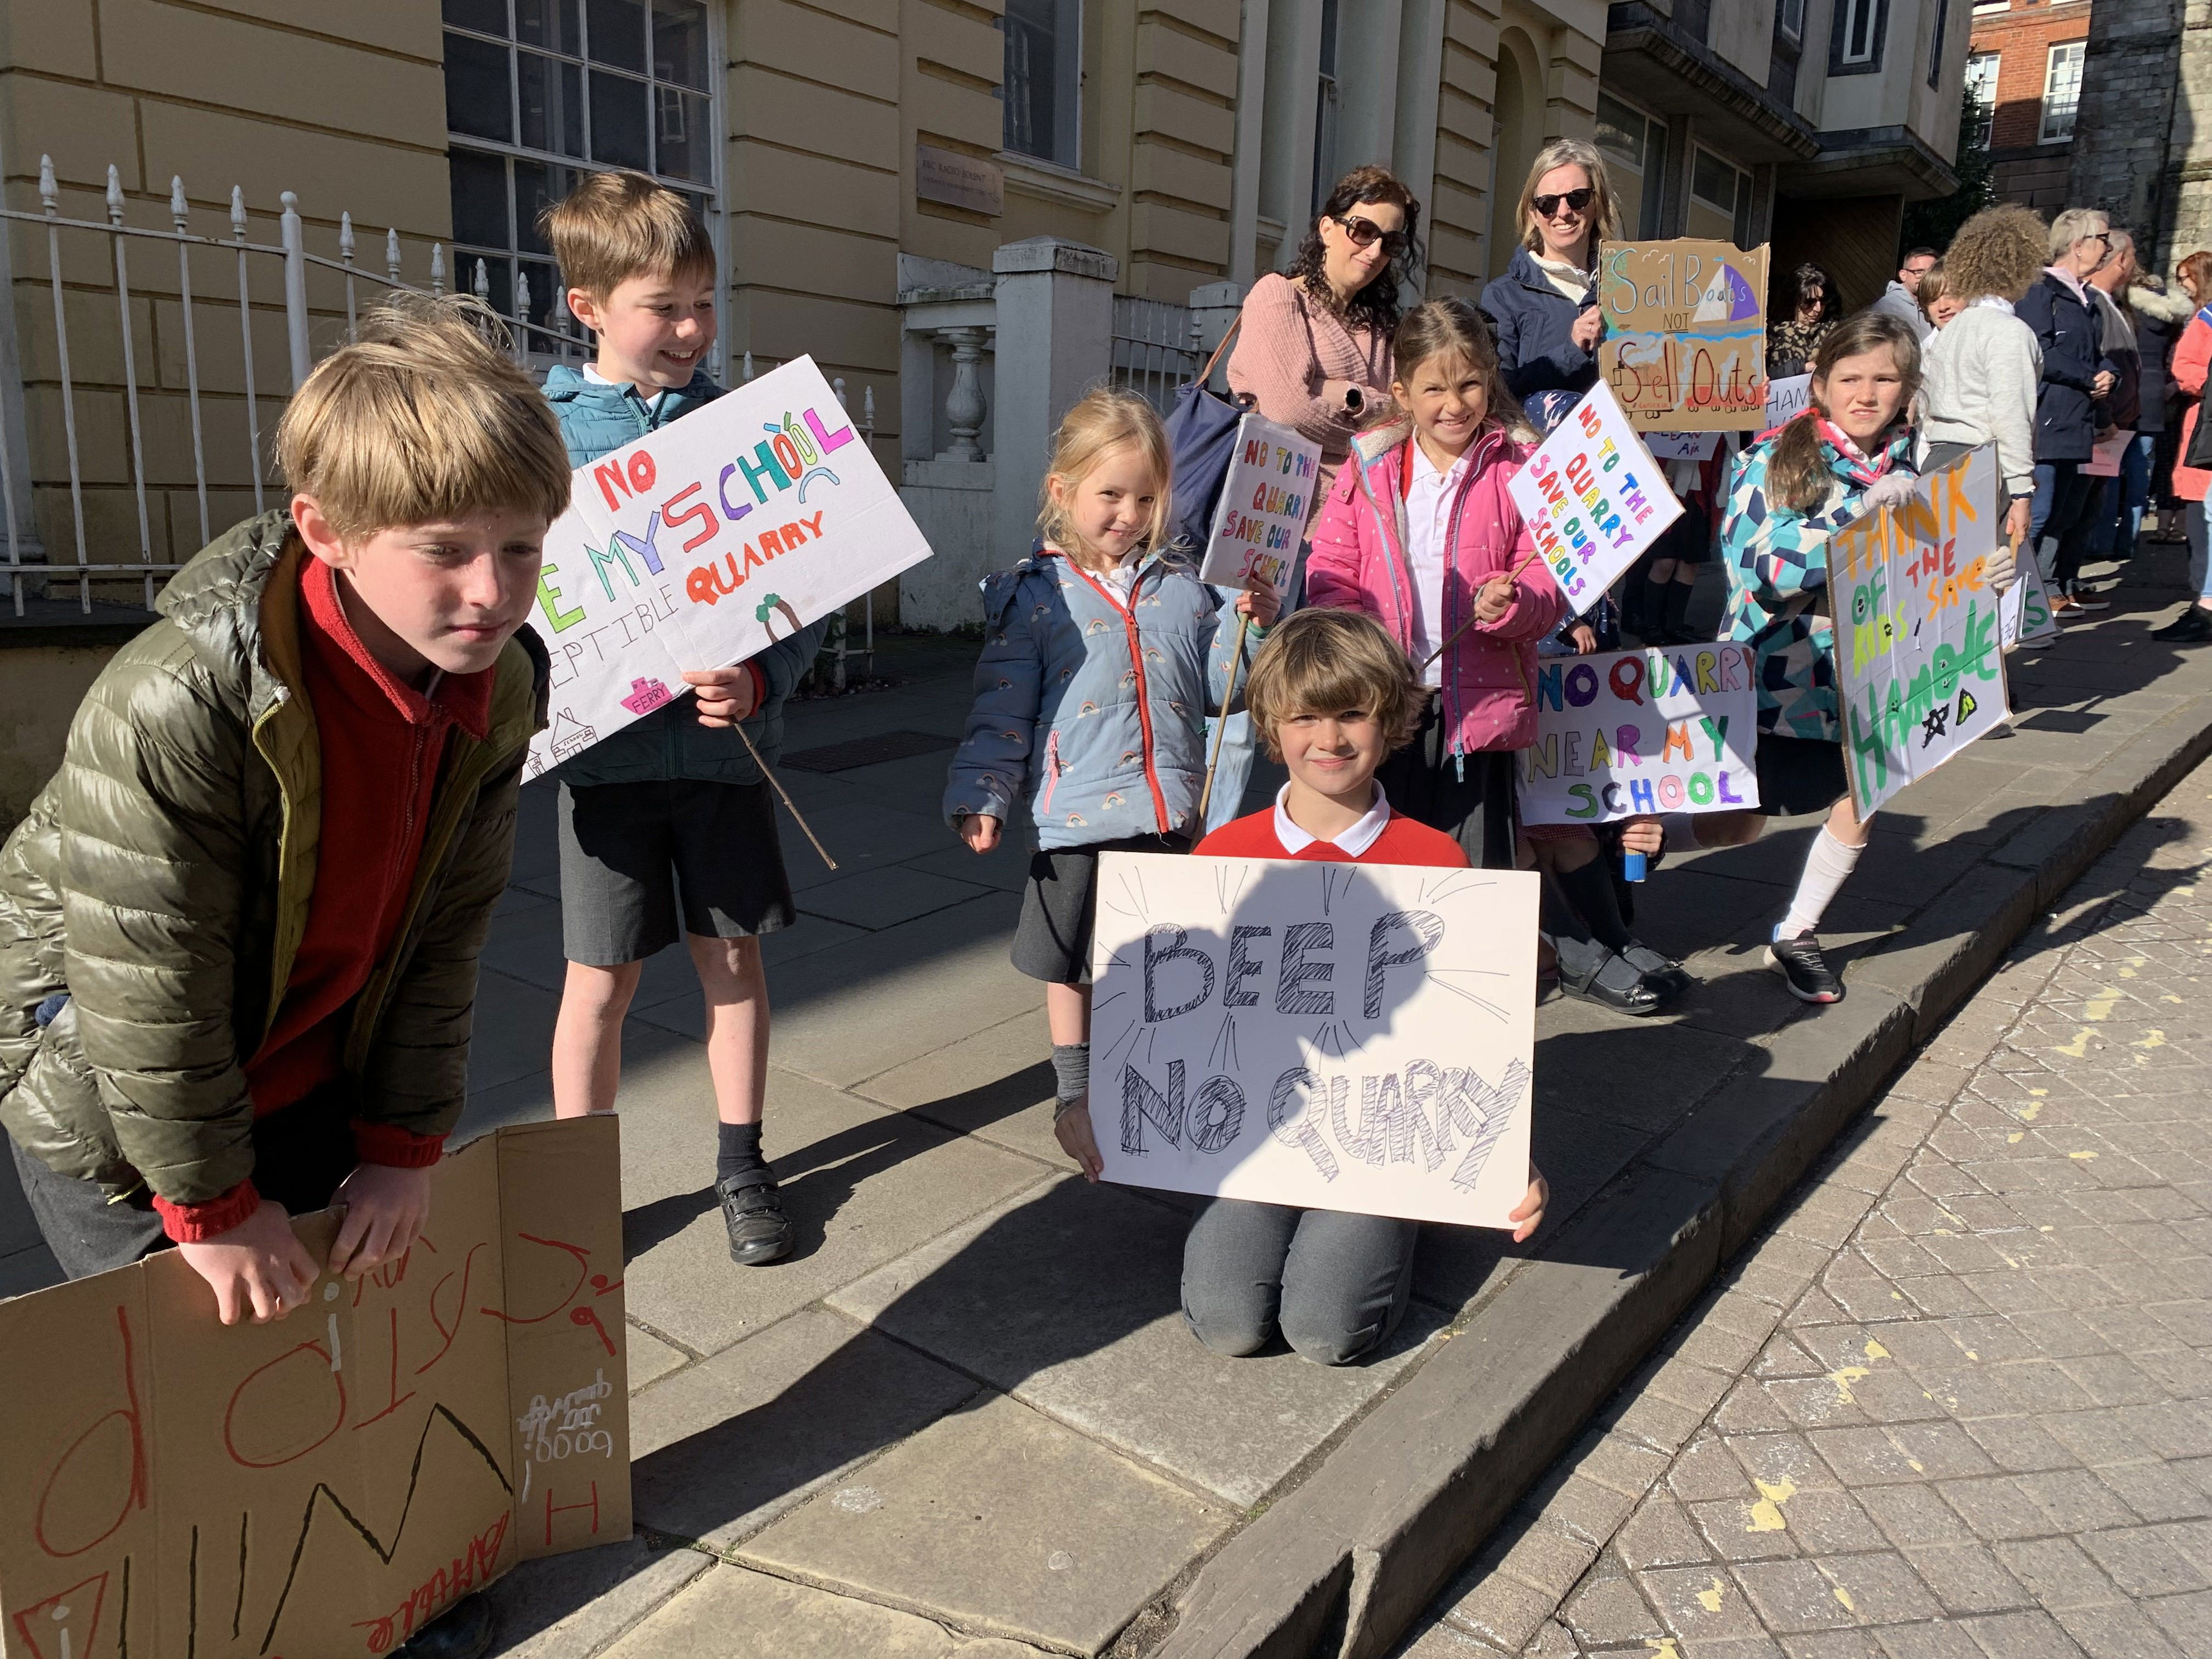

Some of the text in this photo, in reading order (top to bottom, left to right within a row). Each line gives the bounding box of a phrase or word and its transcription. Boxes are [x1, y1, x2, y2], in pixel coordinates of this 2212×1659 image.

[1611, 247, 1747, 315] Sail Boats
[1663, 312, 1689, 330] NOT
[1620, 341, 1758, 406] Sell Outs
[1766, 386, 1809, 413] HAN
[594, 450, 656, 512] NO
[1244, 439, 1317, 480] NO TO THE
[1578, 403, 1654, 525] NO TO THE
[584, 511, 665, 602] MY
[662, 407, 854, 553] SCHOOL
[1222, 510, 1291, 551] SAVE OUR
[1252, 481, 1307, 521] QUARRY
[1530, 454, 1597, 565] SAVE OUR
[1565, 452, 1635, 549] QUARRY
[1836, 456, 1978, 581] THINK
[1237, 548, 1289, 587] SCHOOL
[1528, 507, 1587, 596] SCHOOLS
[1852, 537, 1956, 625] OF THE
[548, 584, 679, 689] EPTIBLE
[686, 510, 823, 606] QUARRY
[632, 684, 666, 713] FERRY
[1538, 647, 1757, 712] NO QUARRY
[1528, 715, 1729, 783] NEAR MY
[1565, 770, 1744, 819] SCHOOL
[1144, 909, 1445, 1023] BEEP
[1120, 1057, 1533, 1195] NO QUARRY
